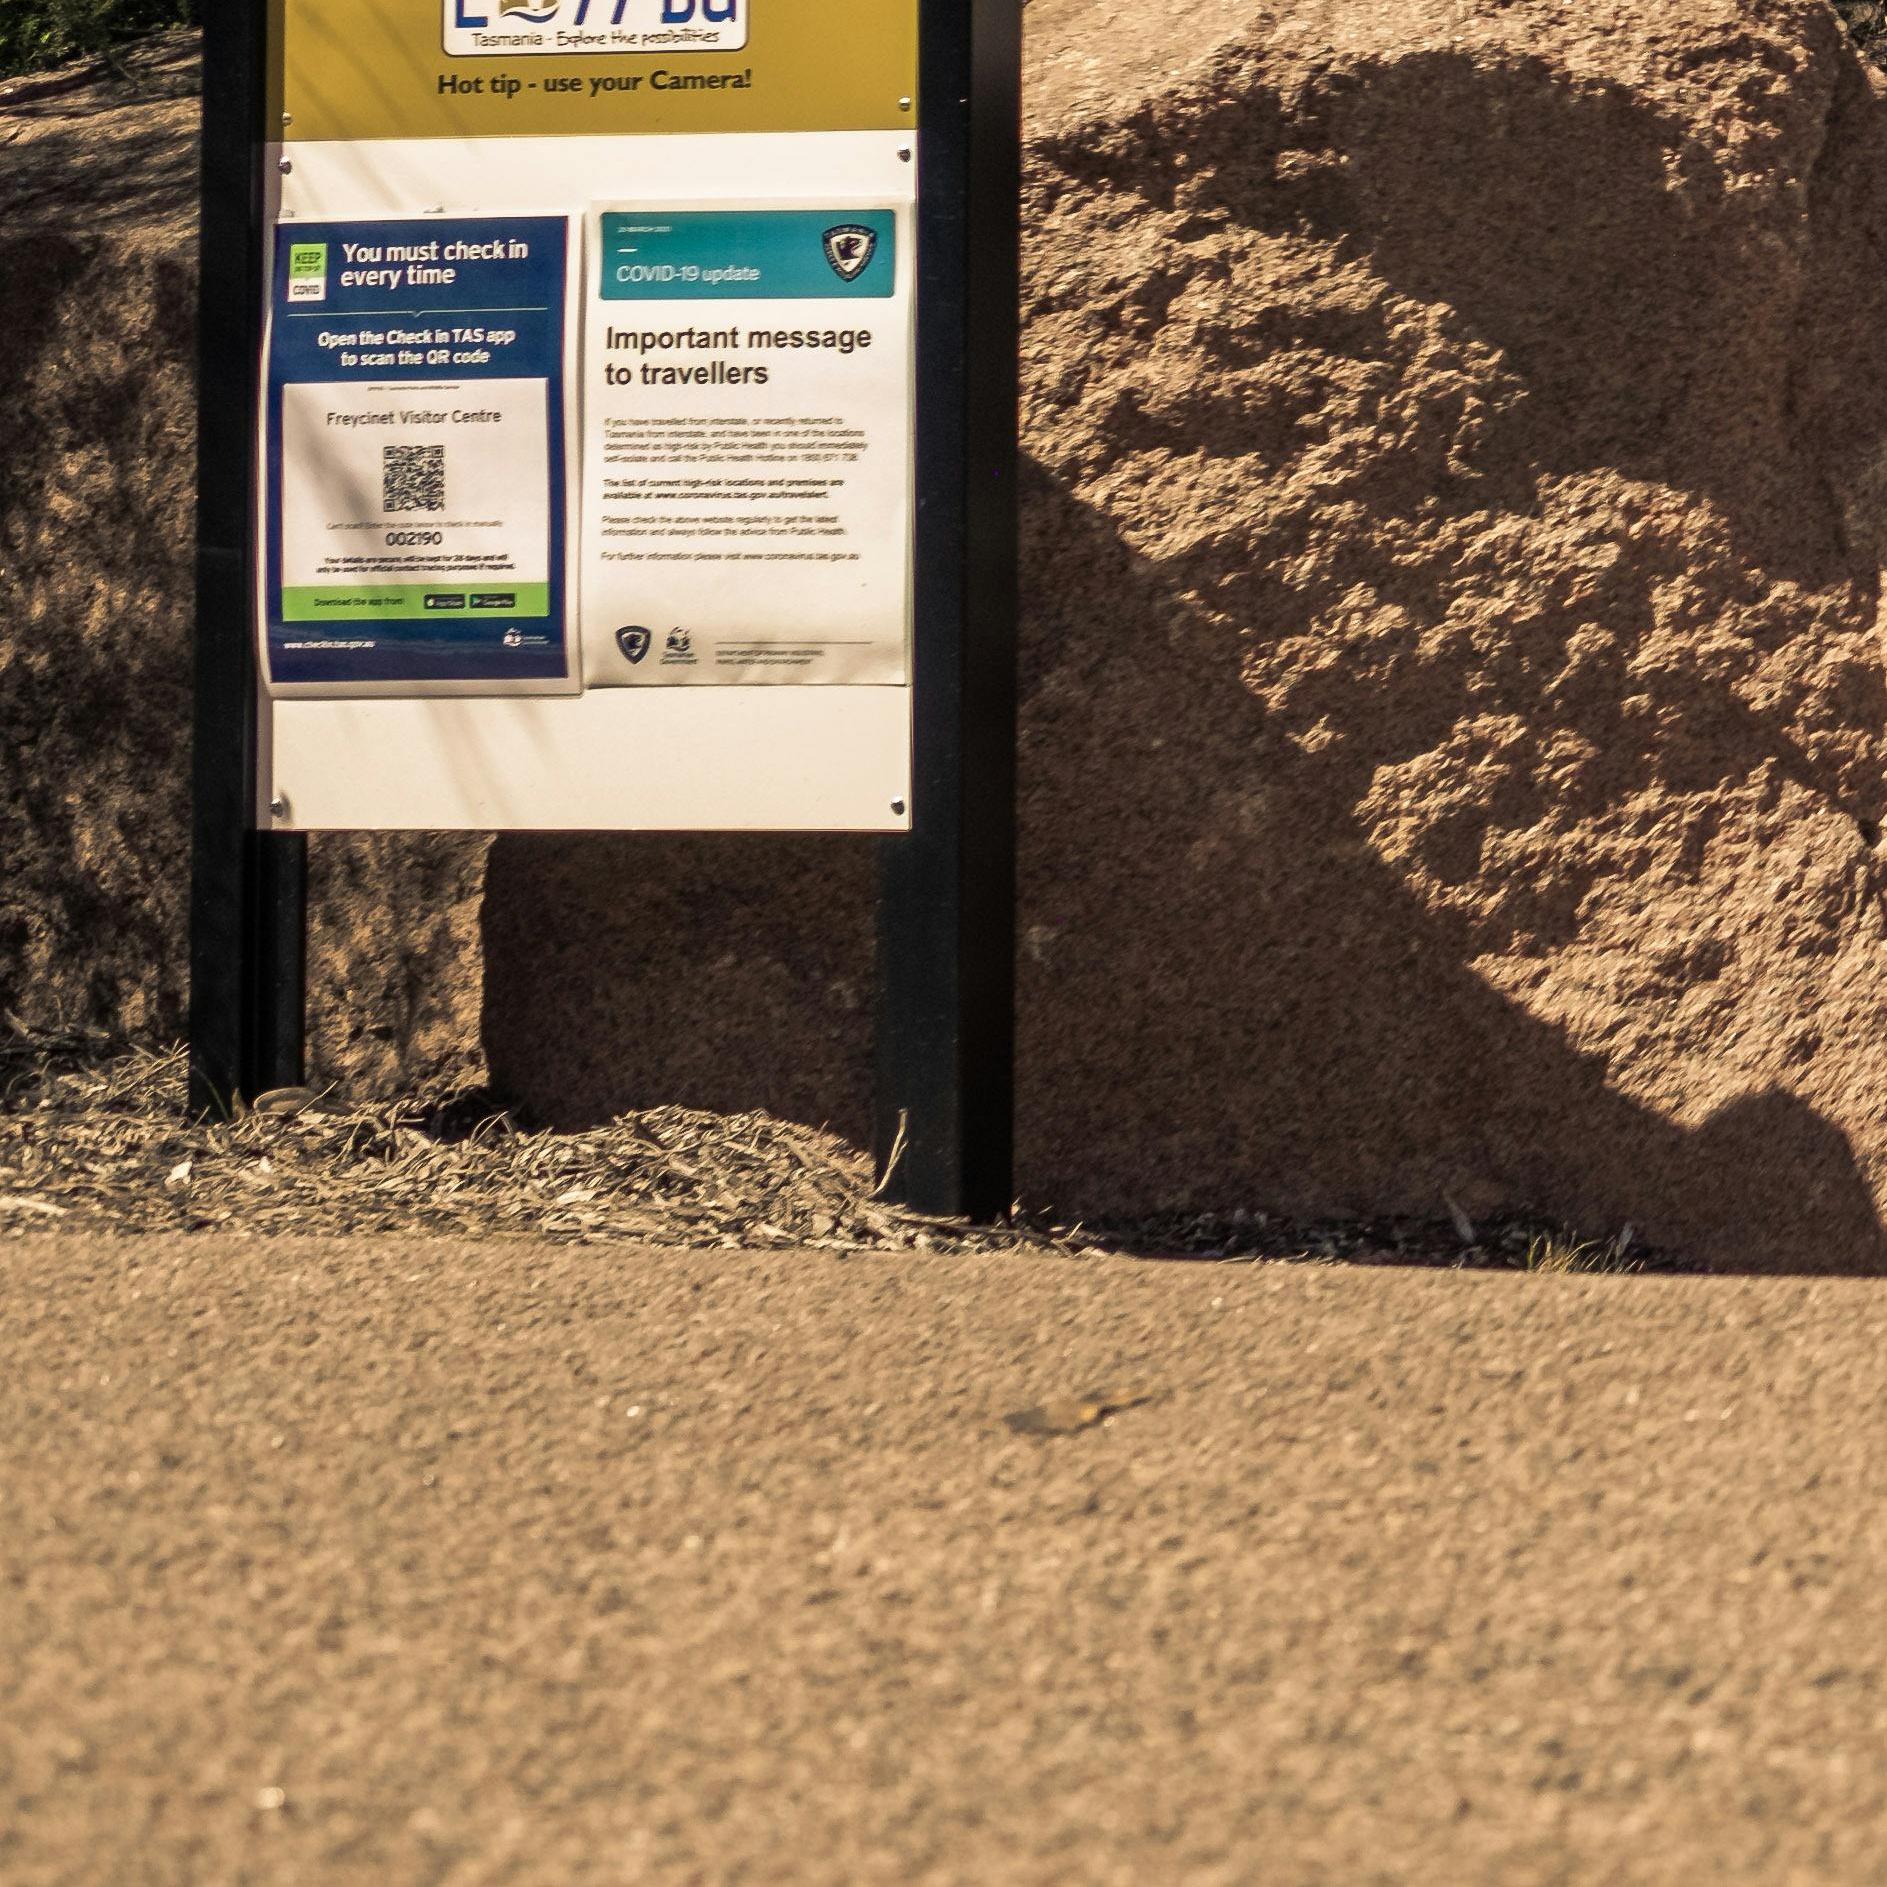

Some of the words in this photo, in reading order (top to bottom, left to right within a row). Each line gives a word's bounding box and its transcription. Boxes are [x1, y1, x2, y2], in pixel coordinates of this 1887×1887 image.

[472, 32, 543, 48] Tasmania
[556, 30, 606, 47] Explore
[610, 30, 637, 45] the
[641, 27, 721, 46] possibilities
[438, 74, 484, 94] Hot
[489, 72, 522, 99] tip
[544, 75, 582, 93] use
[587, 75, 643, 98] your
[649, 68, 753, 92] Camera!
[342, 243, 381, 263] You
[386, 241, 438, 262] must
[443, 239, 505, 261] check
[508, 238, 529, 259] in
[340, 270, 402, 290] every
[407, 264, 456, 285] time
[616, 265, 700, 282] COVID-19
[703, 265, 761, 286] update
[317, 331, 357, 349] Open
[359, 330, 383, 345] the
[386, 329, 432, 344] Check
[434, 329, 450, 344] in
[452, 328, 485, 343] TAS
[486, 331, 516, 346] app
[606, 326, 740, 355] Important
[748, 330, 872, 354] message
[341, 352, 357, 366] to
[360, 353, 395, 366] scan
[397, 350, 424, 365] the
[426, 350, 450, 365] QR
[452, 348, 491, 364] code
[605, 363, 631, 385] to
[639, 361, 769, 385] travellers
[326, 411, 394, 428] Freycinet
[398, 410, 448, 424] Visitor
[451, 409, 502, 424] Centre
[385, 532, 443, 546] 002190
